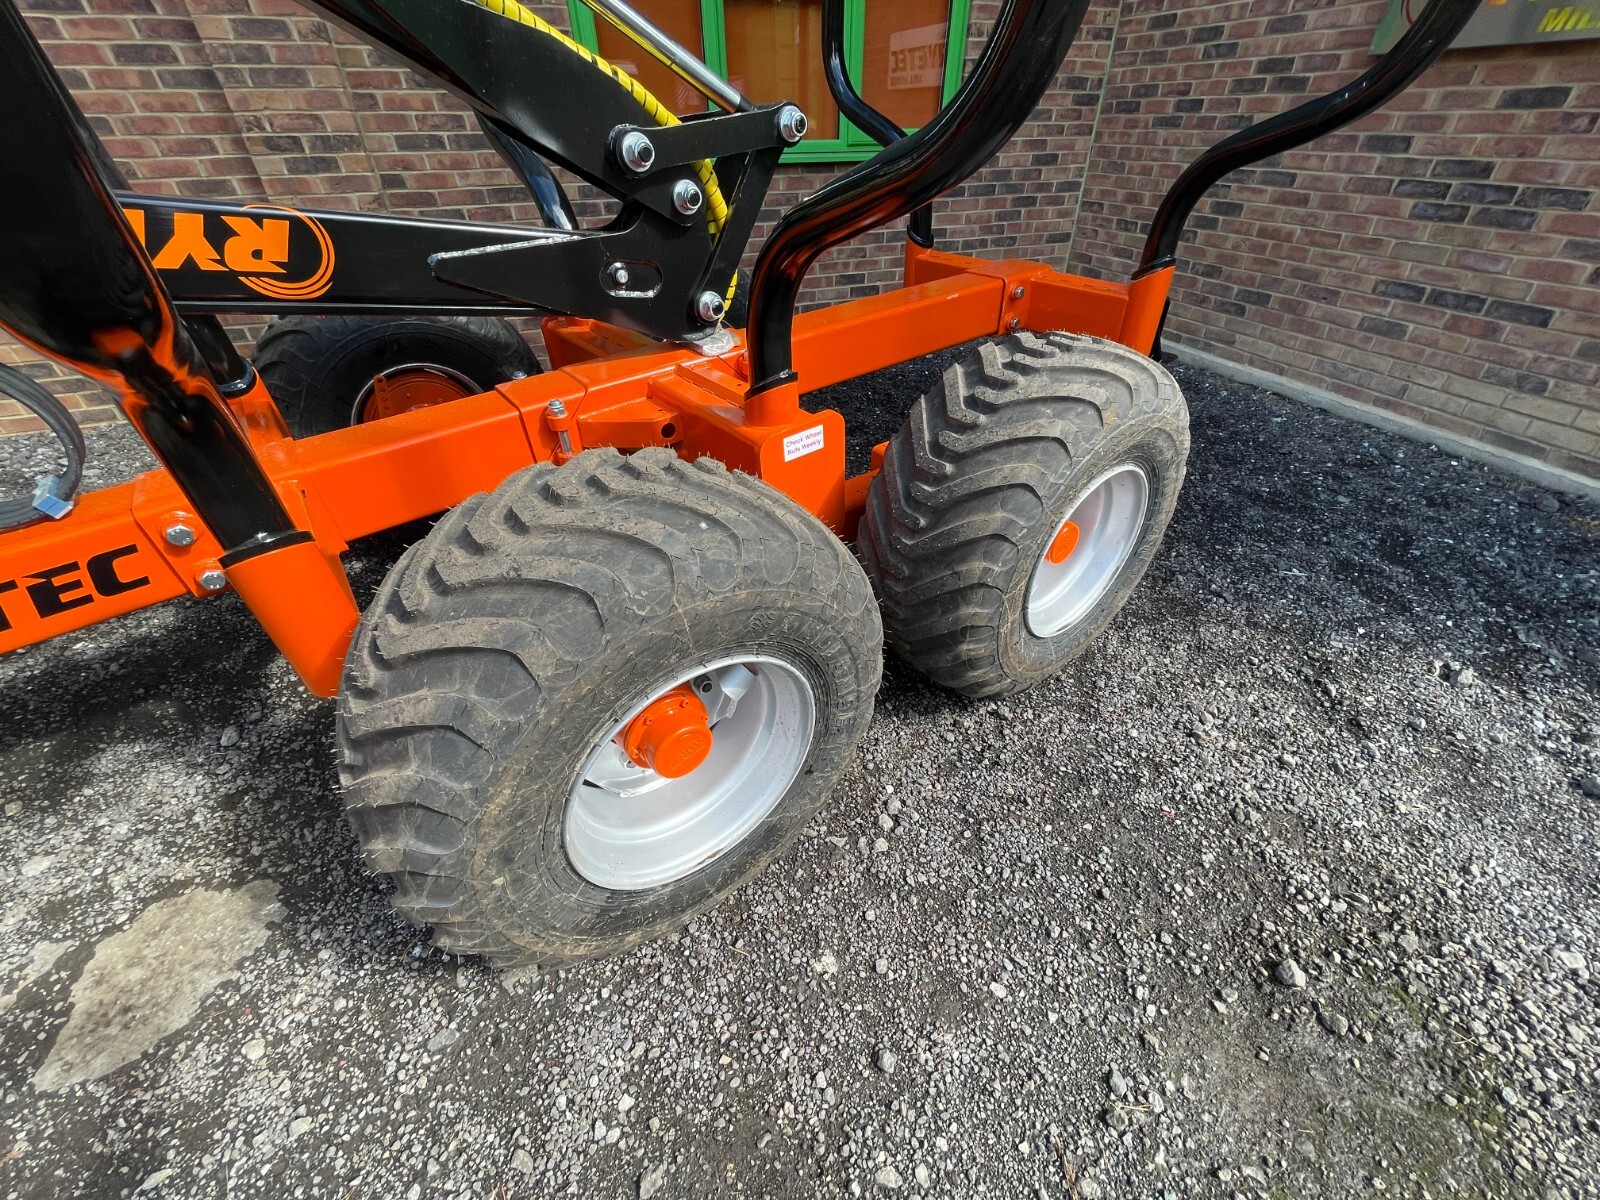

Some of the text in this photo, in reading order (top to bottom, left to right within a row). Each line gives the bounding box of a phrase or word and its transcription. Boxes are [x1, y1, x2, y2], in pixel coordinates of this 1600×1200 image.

[786, 429, 822, 448] Check Wheel
[787, 438, 822, 456] Nuts Weekly
